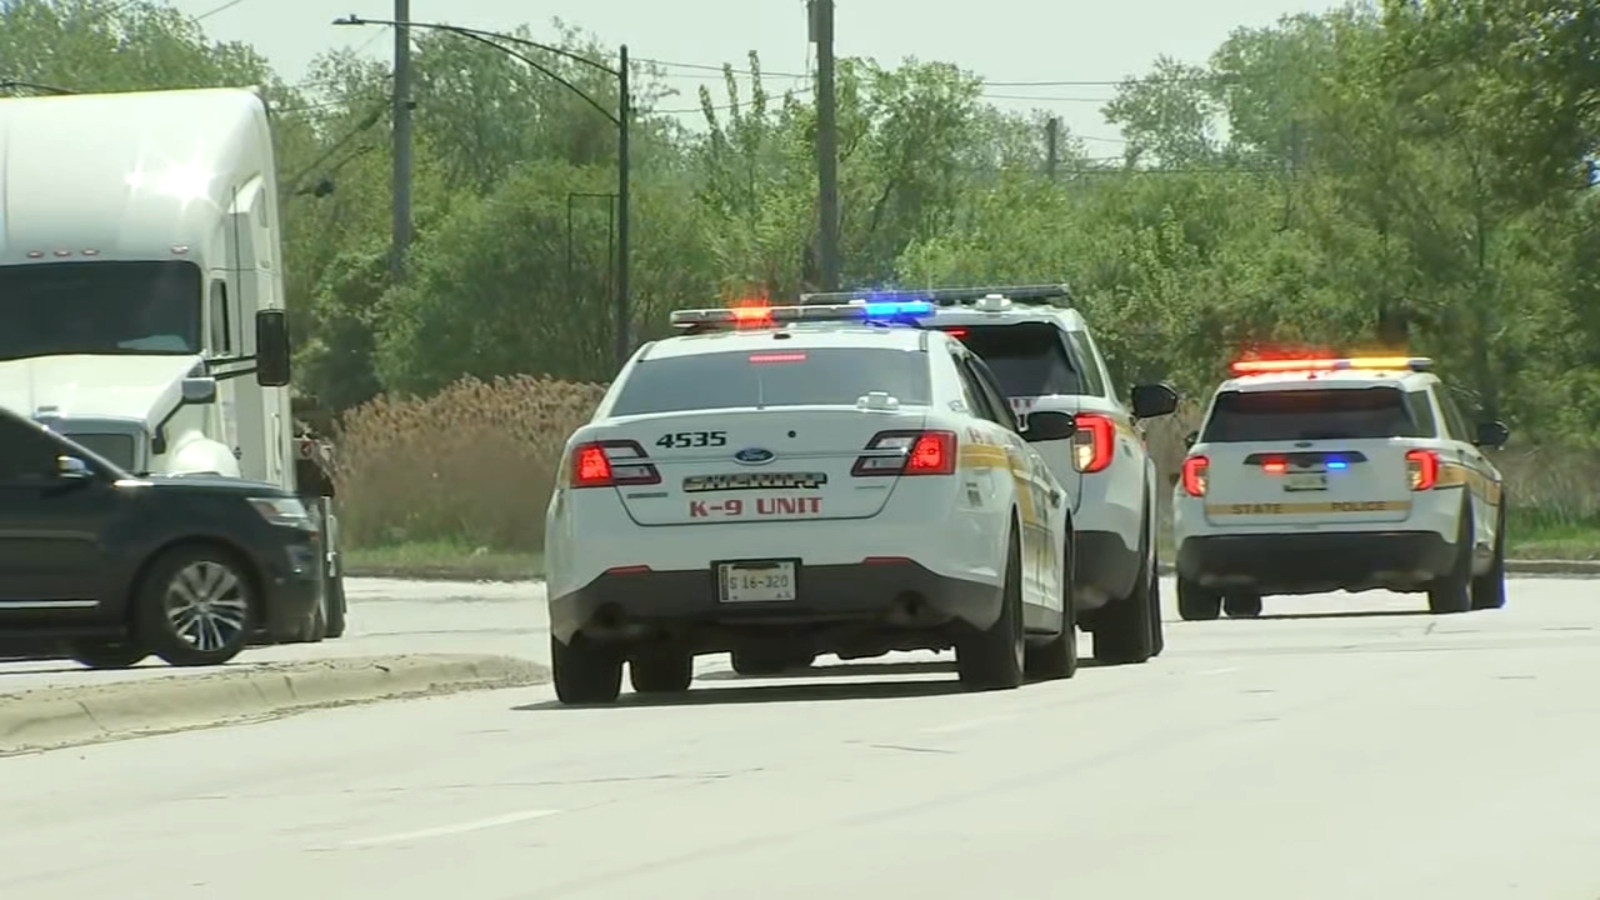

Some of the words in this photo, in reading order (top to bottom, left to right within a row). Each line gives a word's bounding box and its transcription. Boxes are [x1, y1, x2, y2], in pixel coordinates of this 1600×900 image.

[656, 431, 727, 448] 4535
[690, 500, 743, 517] K-9
[756, 497, 823, 515] UNIT
[1232, 503, 1283, 515] STATE
[1331, 501, 1387, 512] POLICE
